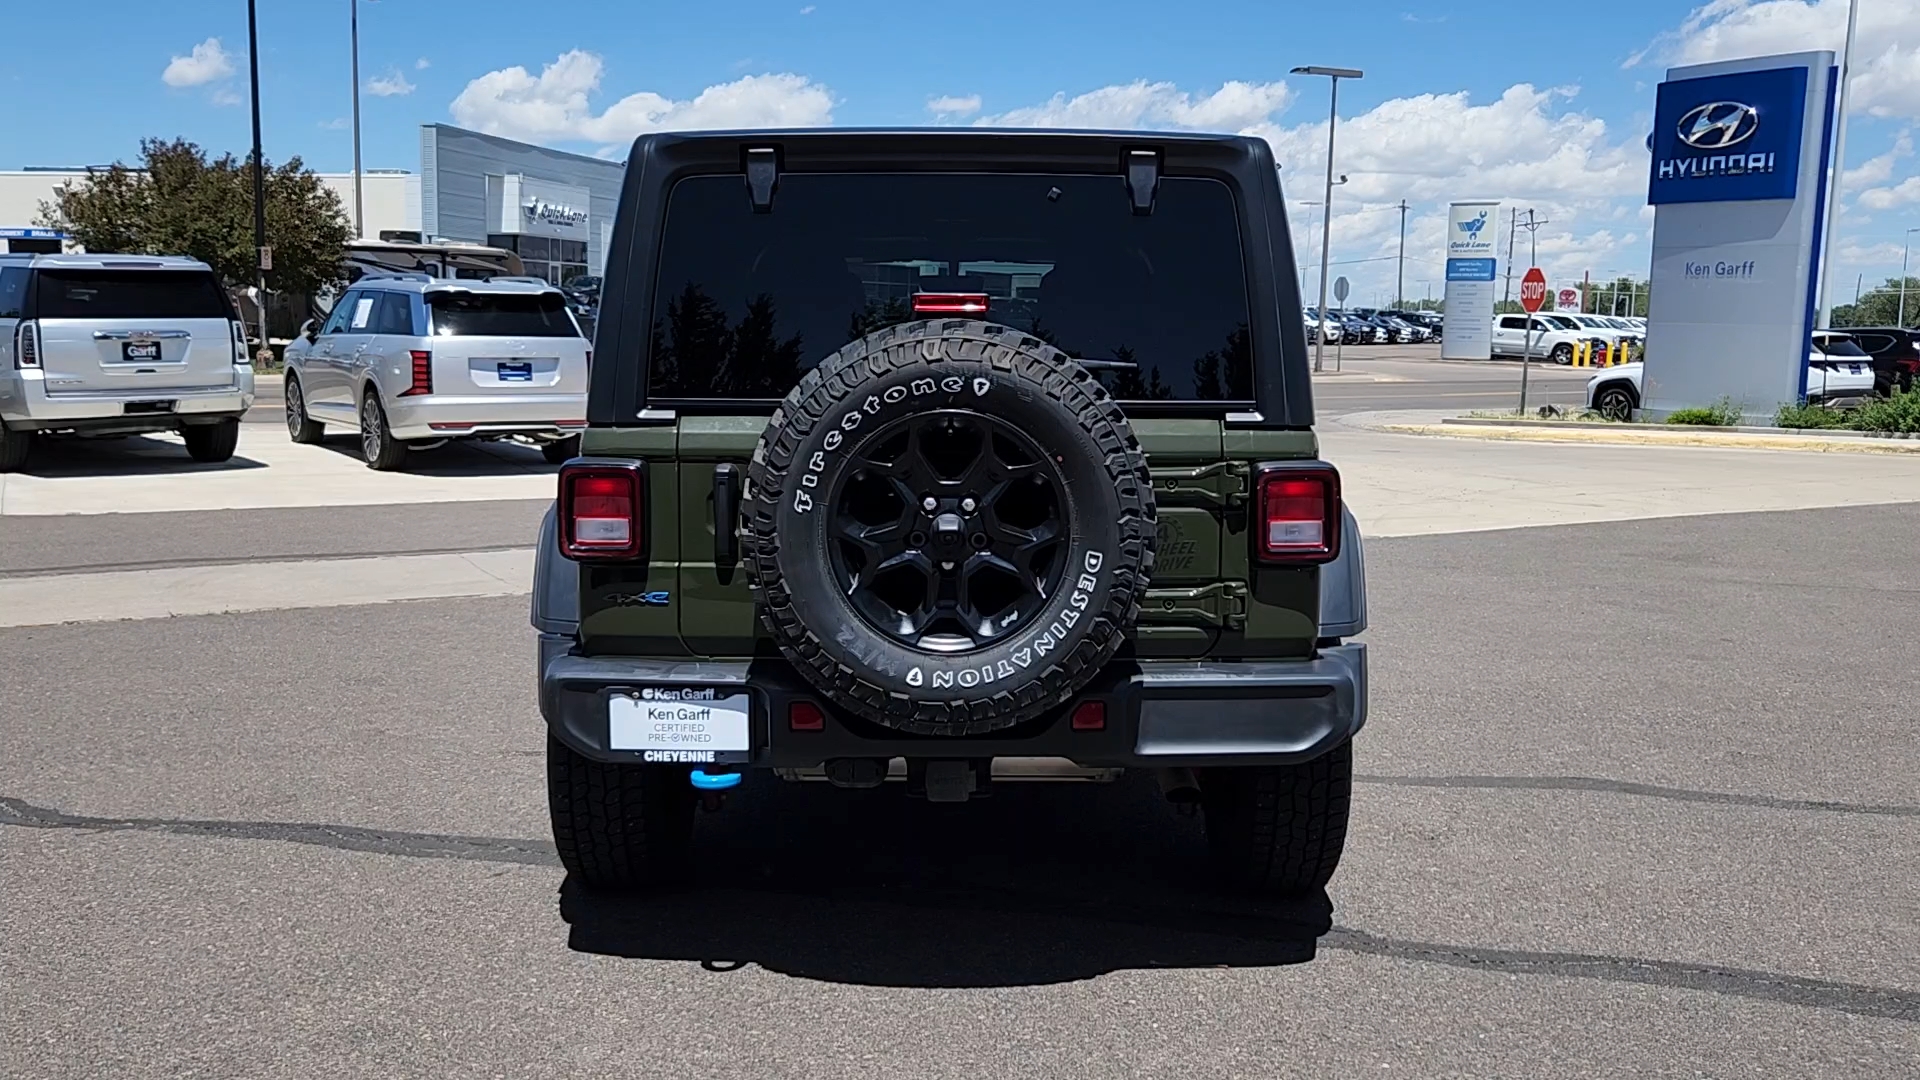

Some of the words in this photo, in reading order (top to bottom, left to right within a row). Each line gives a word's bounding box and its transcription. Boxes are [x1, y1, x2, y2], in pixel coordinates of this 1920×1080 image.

[1659, 152, 1775, 179] HYUNDAI
[1450, 241, 1471, 249] Quick
[1471, 241, 1491, 249] Lane
[1685, 261, 1710, 277] Ken
[1715, 260, 1755, 277] Garff
[1522, 281, 1544, 300] STOP
[127, 345, 158, 357] Garff
[793, 376, 965, 513] Firestone
[1156, 541, 1197, 556] HEEL
[931, 550, 1104, 689] DESTINATION
[654, 687, 680, 700] Ken
[681, 688, 715, 701] Garff
[648, 708, 675, 720] Ken
[676, 708, 712, 721] Garff
[654, 723, 705, 733] CERTIFIED
[644, 751, 715, 763] CHEYENNE
